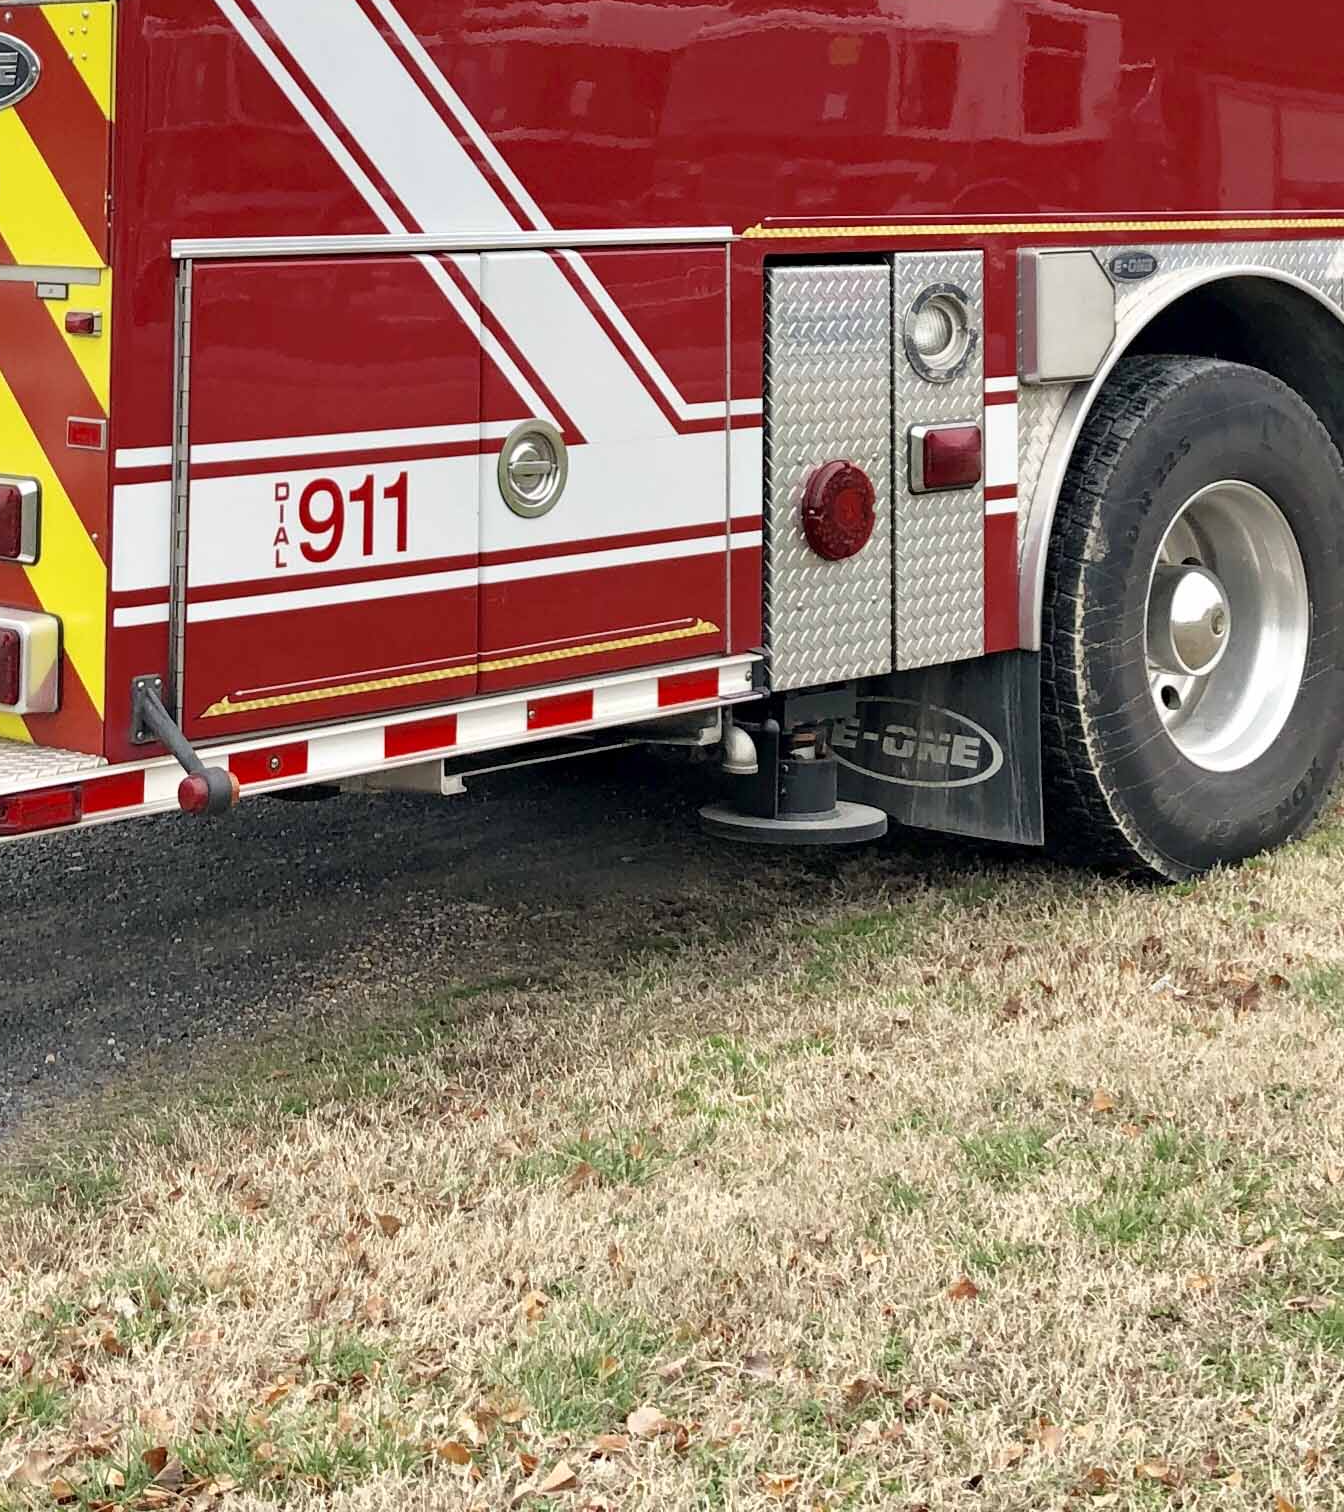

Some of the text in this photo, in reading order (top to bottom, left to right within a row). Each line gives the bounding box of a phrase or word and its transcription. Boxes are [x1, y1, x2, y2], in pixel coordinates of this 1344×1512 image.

[1114, 258, 1153, 273] E-ONE
[274, 471, 408, 568] DIAL 911
[832, 717, 981, 768] E-ONE
